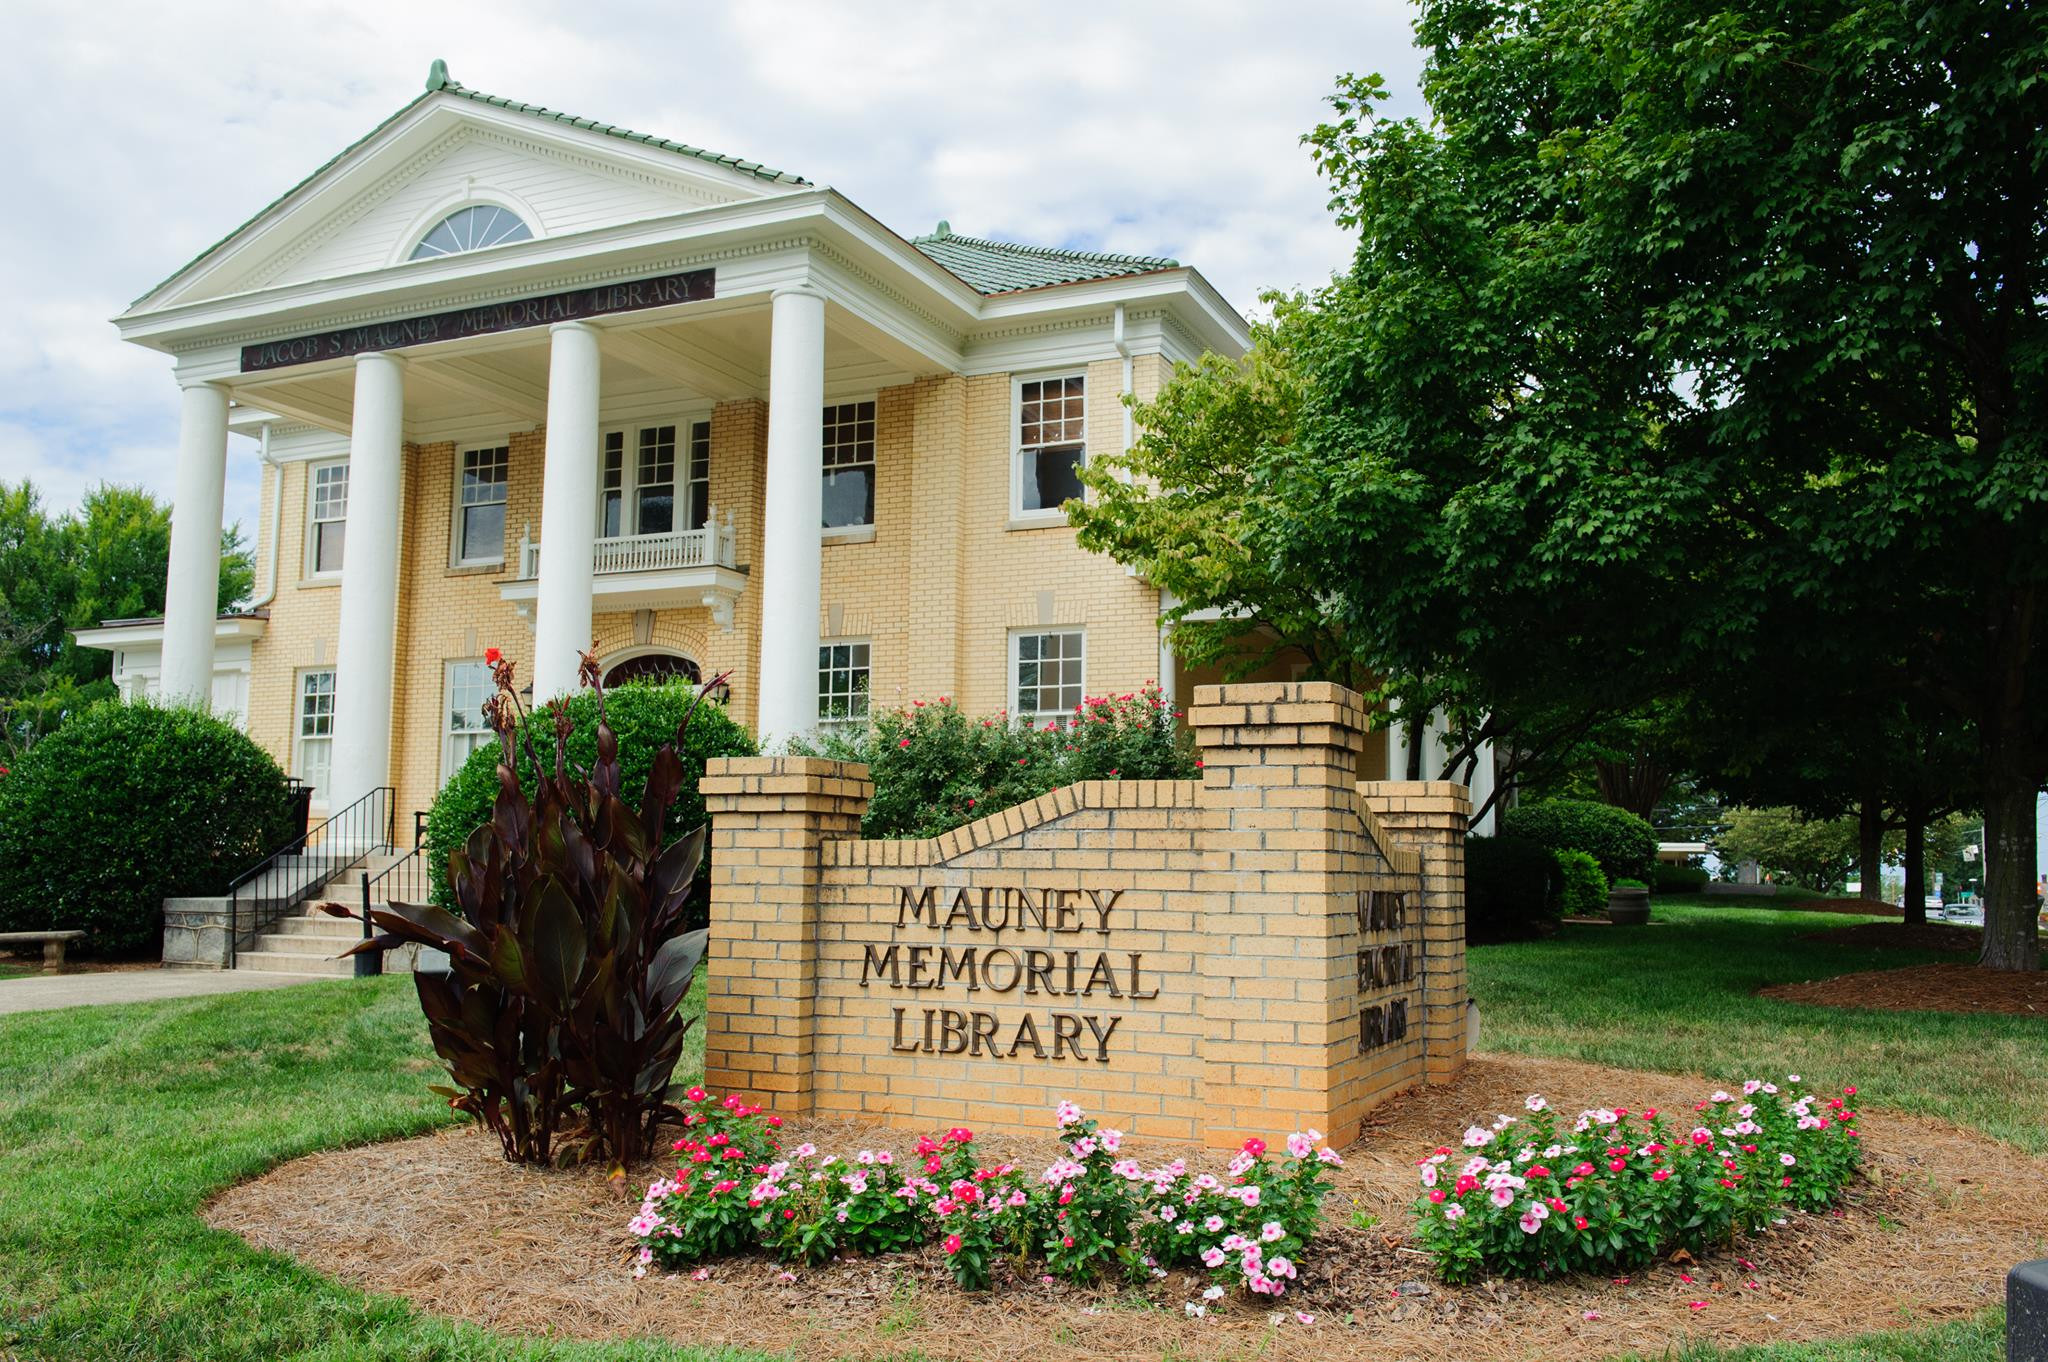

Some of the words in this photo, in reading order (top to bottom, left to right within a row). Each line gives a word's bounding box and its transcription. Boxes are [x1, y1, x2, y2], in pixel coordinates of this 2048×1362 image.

[252, 340, 319, 367] JACOB
[353, 317, 444, 350] MAUNEY
[459, 295, 577, 332] MEMORIAL
[593, 276, 695, 311] LIBRARY
[896, 885, 1125, 934] MAUNEY
[858, 943, 1160, 1000] MEMORIAL
[890, 1007, 1123, 1062] LIBRARY
